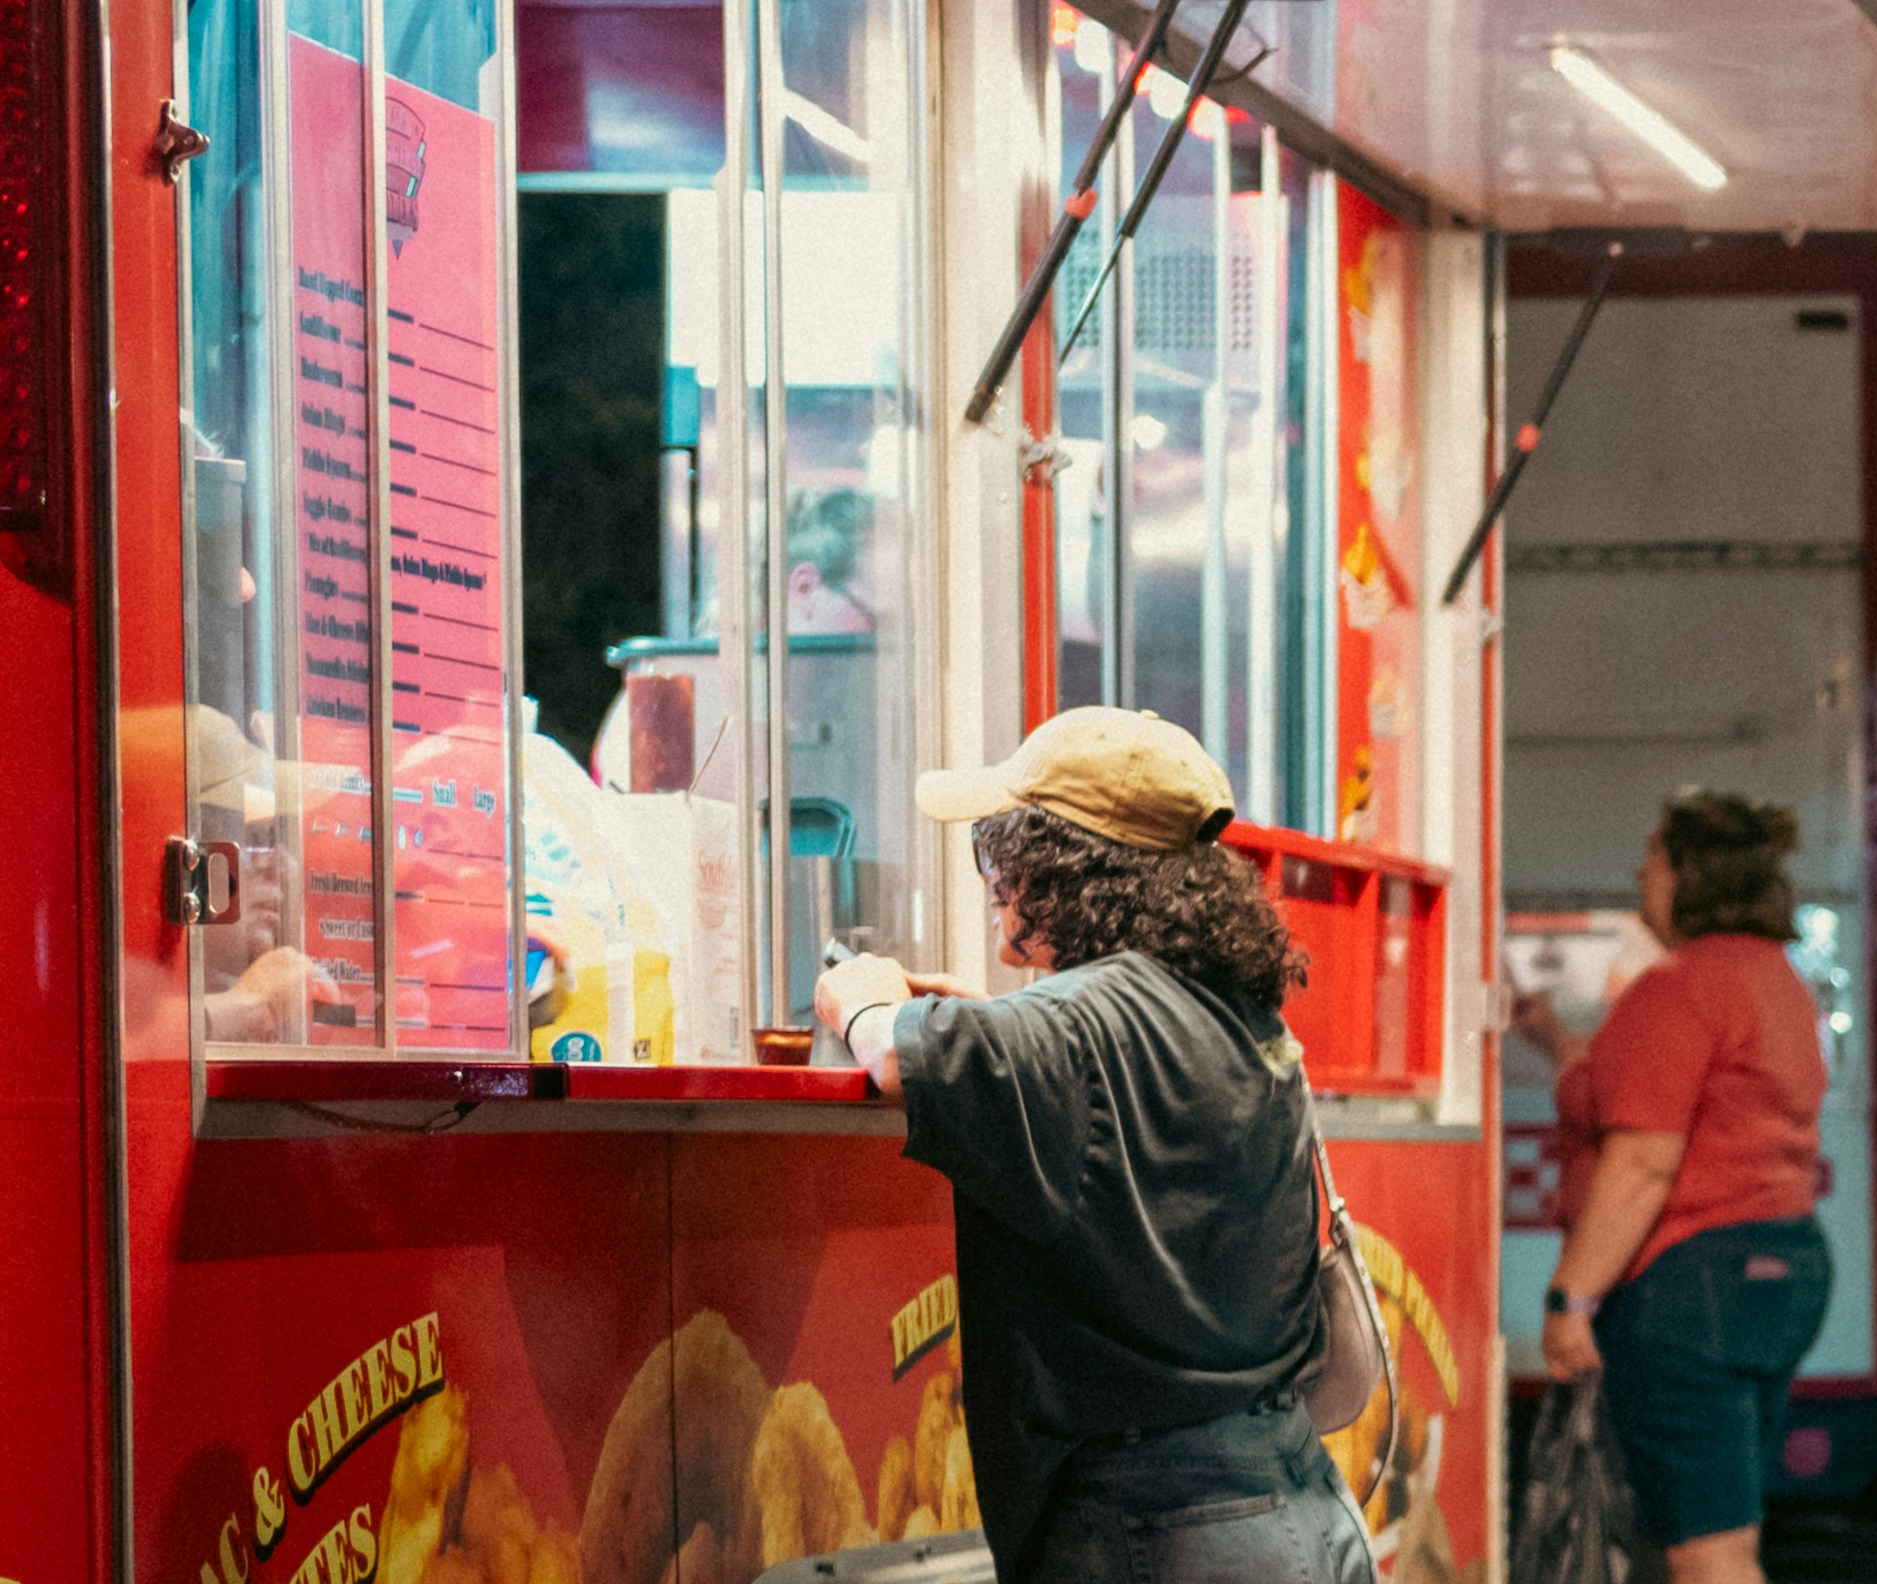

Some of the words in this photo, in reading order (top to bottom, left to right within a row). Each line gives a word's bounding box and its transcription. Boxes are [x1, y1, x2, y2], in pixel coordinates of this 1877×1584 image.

[891, 1273, 956, 1370] FRIED
[253, 1467, 285, 1548] &
[288, 1311, 444, 1493] CHEESE
